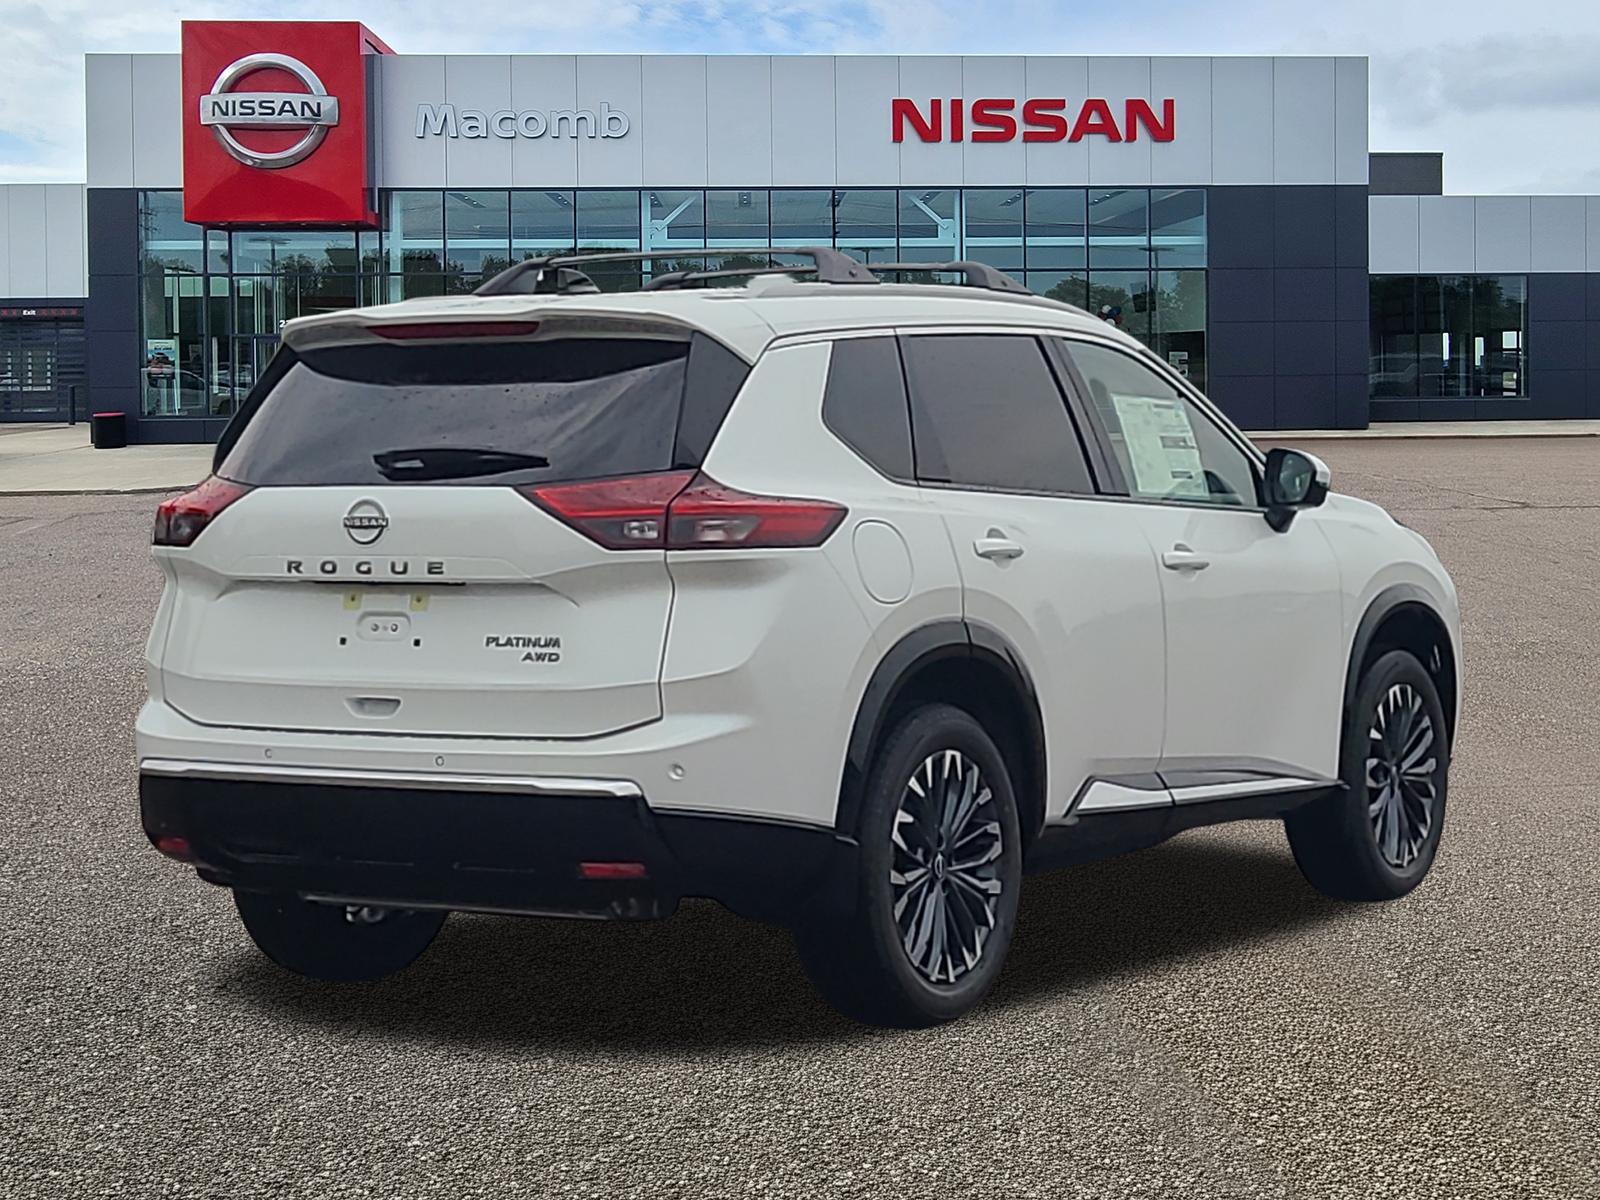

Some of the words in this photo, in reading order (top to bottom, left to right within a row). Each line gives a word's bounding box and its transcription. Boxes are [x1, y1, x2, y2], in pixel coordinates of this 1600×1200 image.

[212, 100, 321, 118] NISSAN
[415, 101, 630, 138] Macomb
[892, 98, 1175, 142] NISSAN
[344, 517, 387, 527] NISSAN
[287, 560, 445, 575] ROGUE
[485, 636, 561, 648] PLATINUM
[521, 651, 560, 663] AWD
